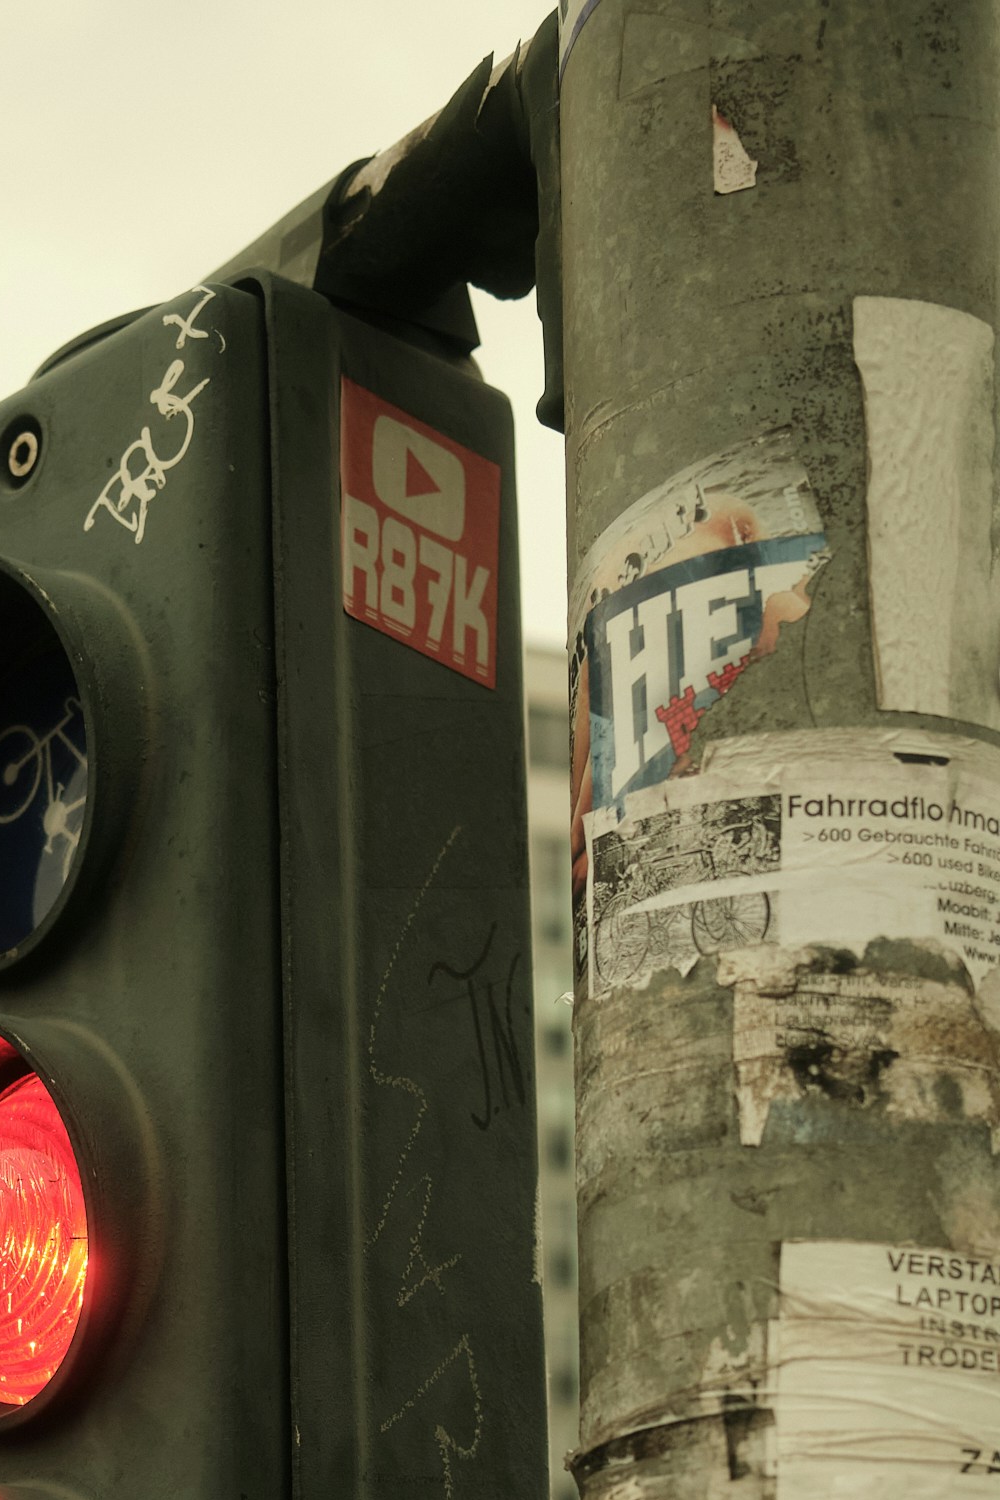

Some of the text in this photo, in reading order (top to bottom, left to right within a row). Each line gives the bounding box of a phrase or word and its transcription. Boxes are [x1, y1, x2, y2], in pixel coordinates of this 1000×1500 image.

[857, 827, 960, 850] Gebrauchte
[938, 857, 973, 875] used
[887, 1250, 1000, 1286] VERSTA
